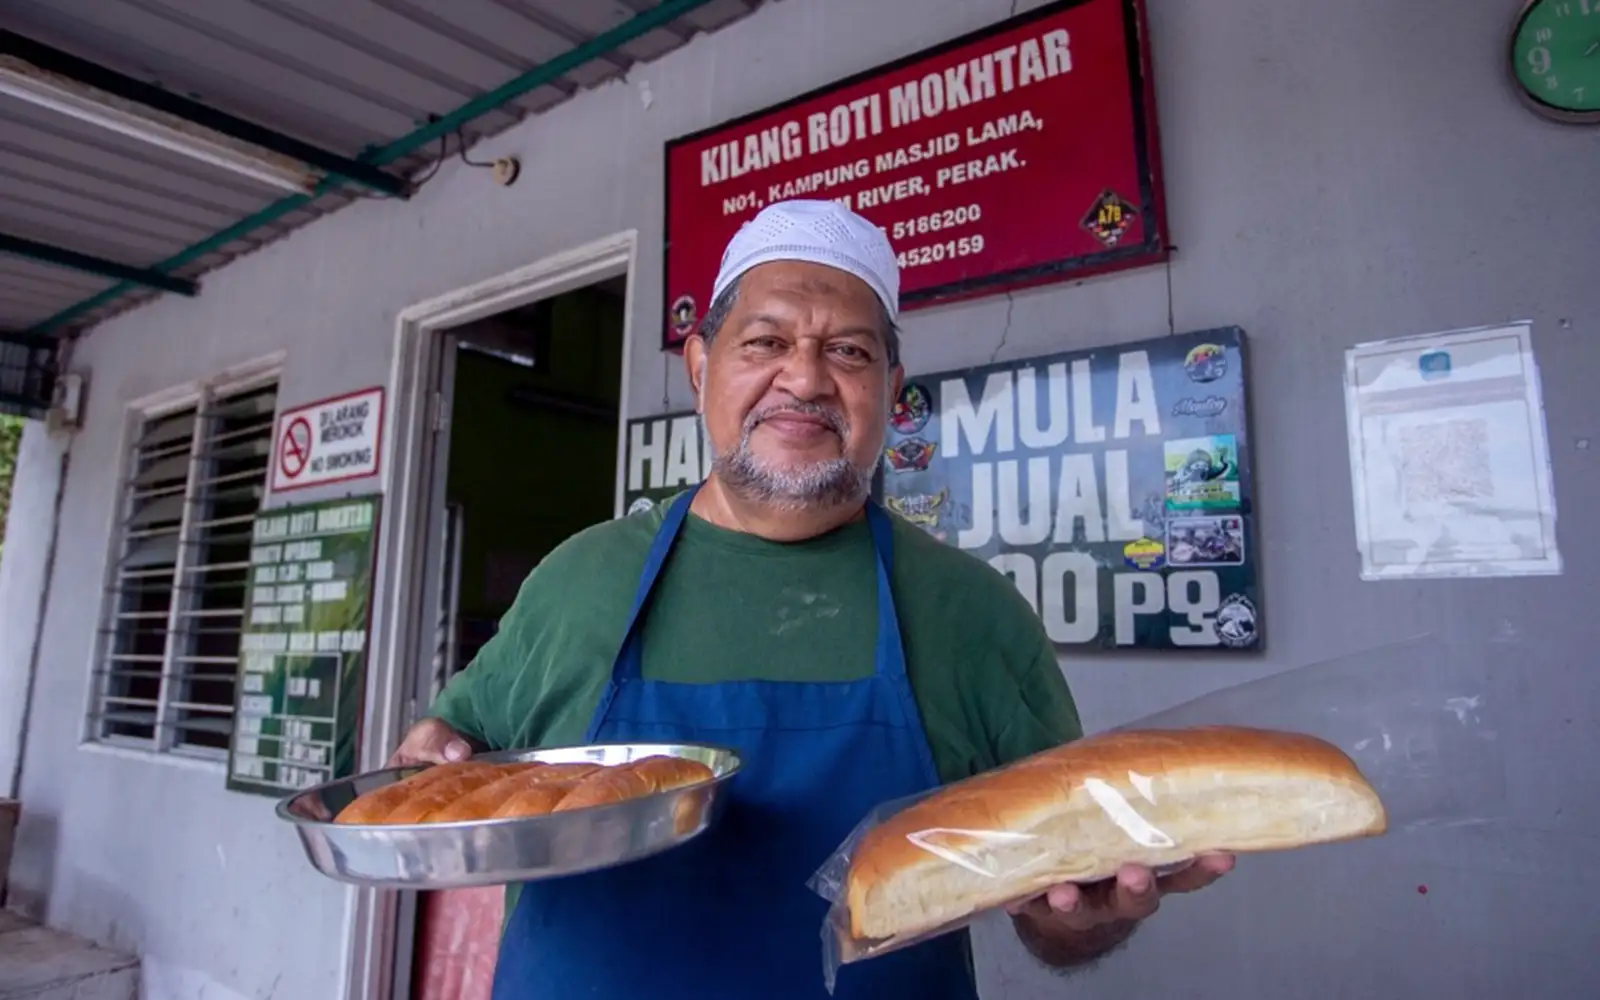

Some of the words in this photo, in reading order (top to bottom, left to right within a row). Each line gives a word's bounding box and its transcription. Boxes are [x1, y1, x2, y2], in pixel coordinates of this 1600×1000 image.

[1528, 46, 1551, 74] 9
[701, 120, 803, 187] KILANG
[807, 93, 883, 154] ROTI
[889, 28, 1073, 128] MOKHTAR
[768, 159, 870, 203] KAMPUNG
[875, 133, 960, 173] MASJID
[966, 110, 1044, 146] LAMA,
[857, 176, 931, 209] RIVER,
[936, 149, 1027, 188] PERAK.
[892, 203, 981, 240] 5186200
[941, 350, 1161, 458] MULA
[326, 448, 371, 471] SMOKING
[958, 450, 1145, 549] JUAL
